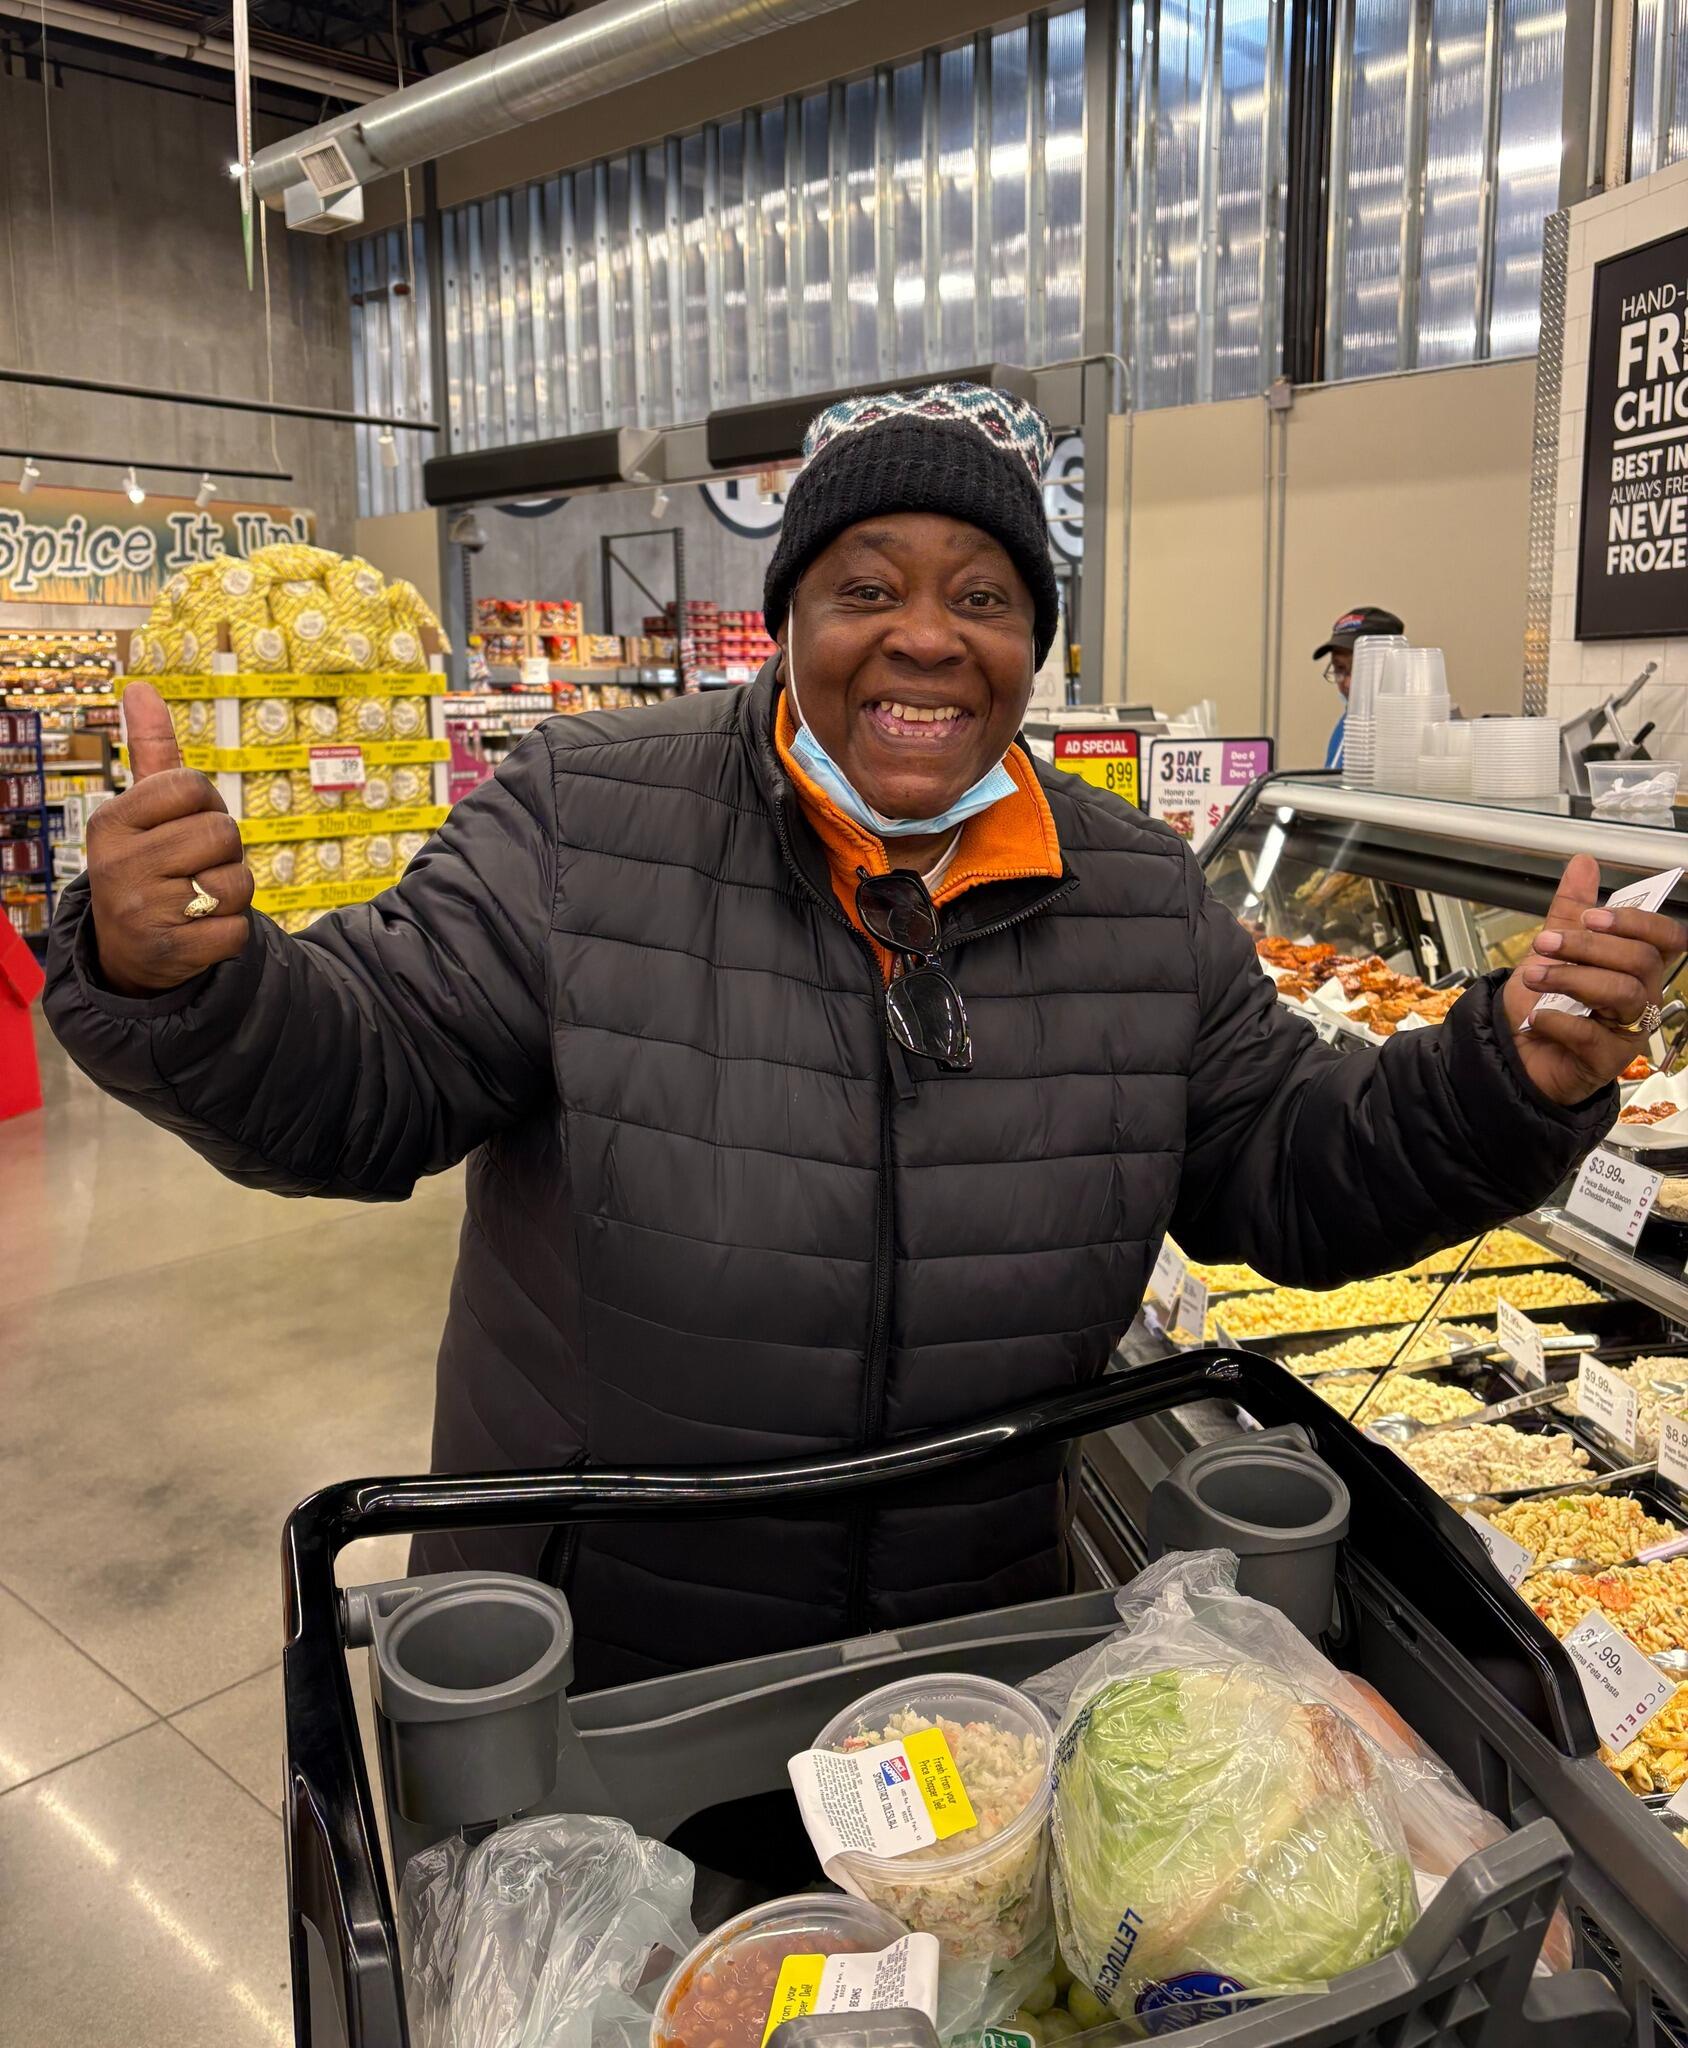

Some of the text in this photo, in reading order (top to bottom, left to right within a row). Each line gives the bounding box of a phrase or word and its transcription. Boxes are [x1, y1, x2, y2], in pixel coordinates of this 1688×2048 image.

[1622, 279, 1688, 322] HAND-
[1614, 377, 1688, 432] CHIC
[1611, 443, 1688, 482] BEST IN
[1609, 479, 1662, 505] ALWAYS
[0, 512, 153, 588] Spice
[170, 516, 222, 562] It
[1065, 740, 1128, 754] AD SPECIAL
[1231, 751, 1247, 760] Dec
[1161, 751, 1202, 780] 3 DAY
[1176, 767, 1211, 783] SALE
[1229, 769, 1246, 778] Dec
[1159, 797, 1183, 807] Virginia
[1164, 789, 1185, 797] Honey
[1584, 1187, 1606, 1204] Cheddar
[1605, 1196, 1623, 1212] Potato
[1597, 1181, 1615, 1197] Baked
[1615, 1190, 1632, 1205] Bacon
[1568, 1645, 1620, 1698] Roma Feta Pasta
[1610, 1702, 1648, 1742] DELI
[881, 1760, 903, 1784] CHOPPER
[890, 1758, 906, 1773] PRICE
[918, 1759, 931, 1775] Price
[925, 1775, 938, 1798] Chopper
[933, 1756, 957, 1804] Fresh from your
[882, 1802, 898, 1830] COLESLAW
[1097, 1907, 1143, 1989] LETTUCE
[786, 1985, 797, 2002] your
[849, 1987, 862, 2007] BEANS
[799, 2001, 808, 2016] pper
